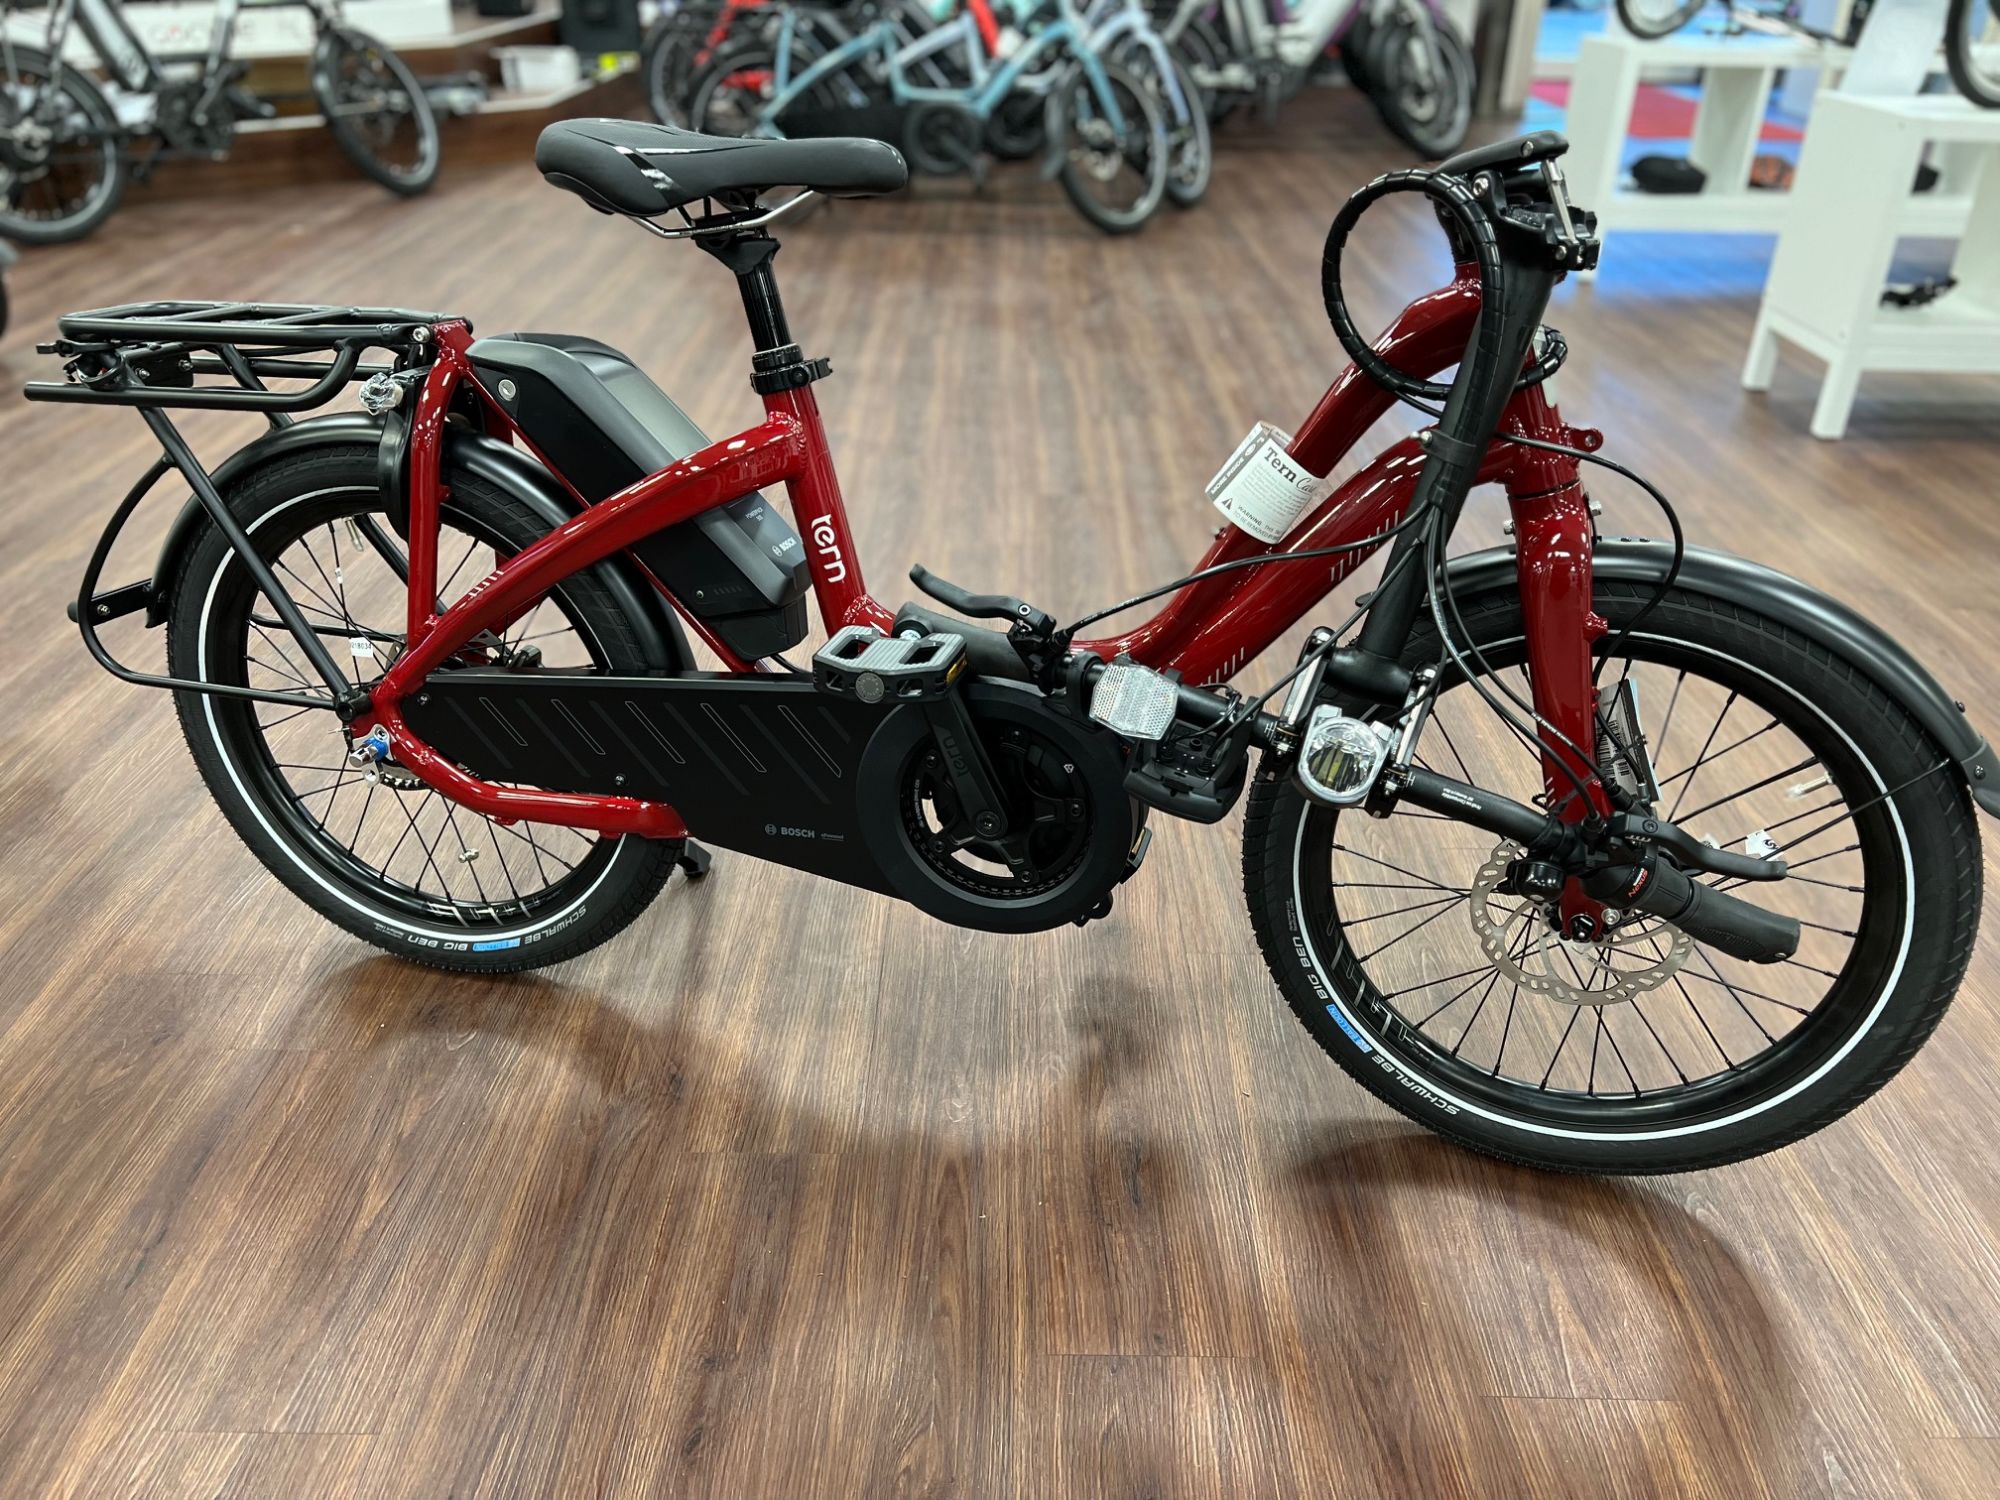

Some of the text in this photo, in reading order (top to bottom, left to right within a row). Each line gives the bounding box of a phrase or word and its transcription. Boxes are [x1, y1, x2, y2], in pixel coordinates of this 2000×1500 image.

[1264, 447, 1297, 483] Tern
[1238, 505, 1262, 526] WARNING
[779, 536, 797, 552] BOSCH
[811, 514, 846, 583] tern
[781, 827, 815, 838] BOSCH
[524, 904, 587, 945] SCHWALBE
[407, 934, 438, 949] BEN
[443, 941, 469, 951] BIG
[1292, 936, 1312, 968] BEN
[1307, 973, 1329, 1000] BIG
[1371, 1054, 1461, 1116] SCHWALBE
